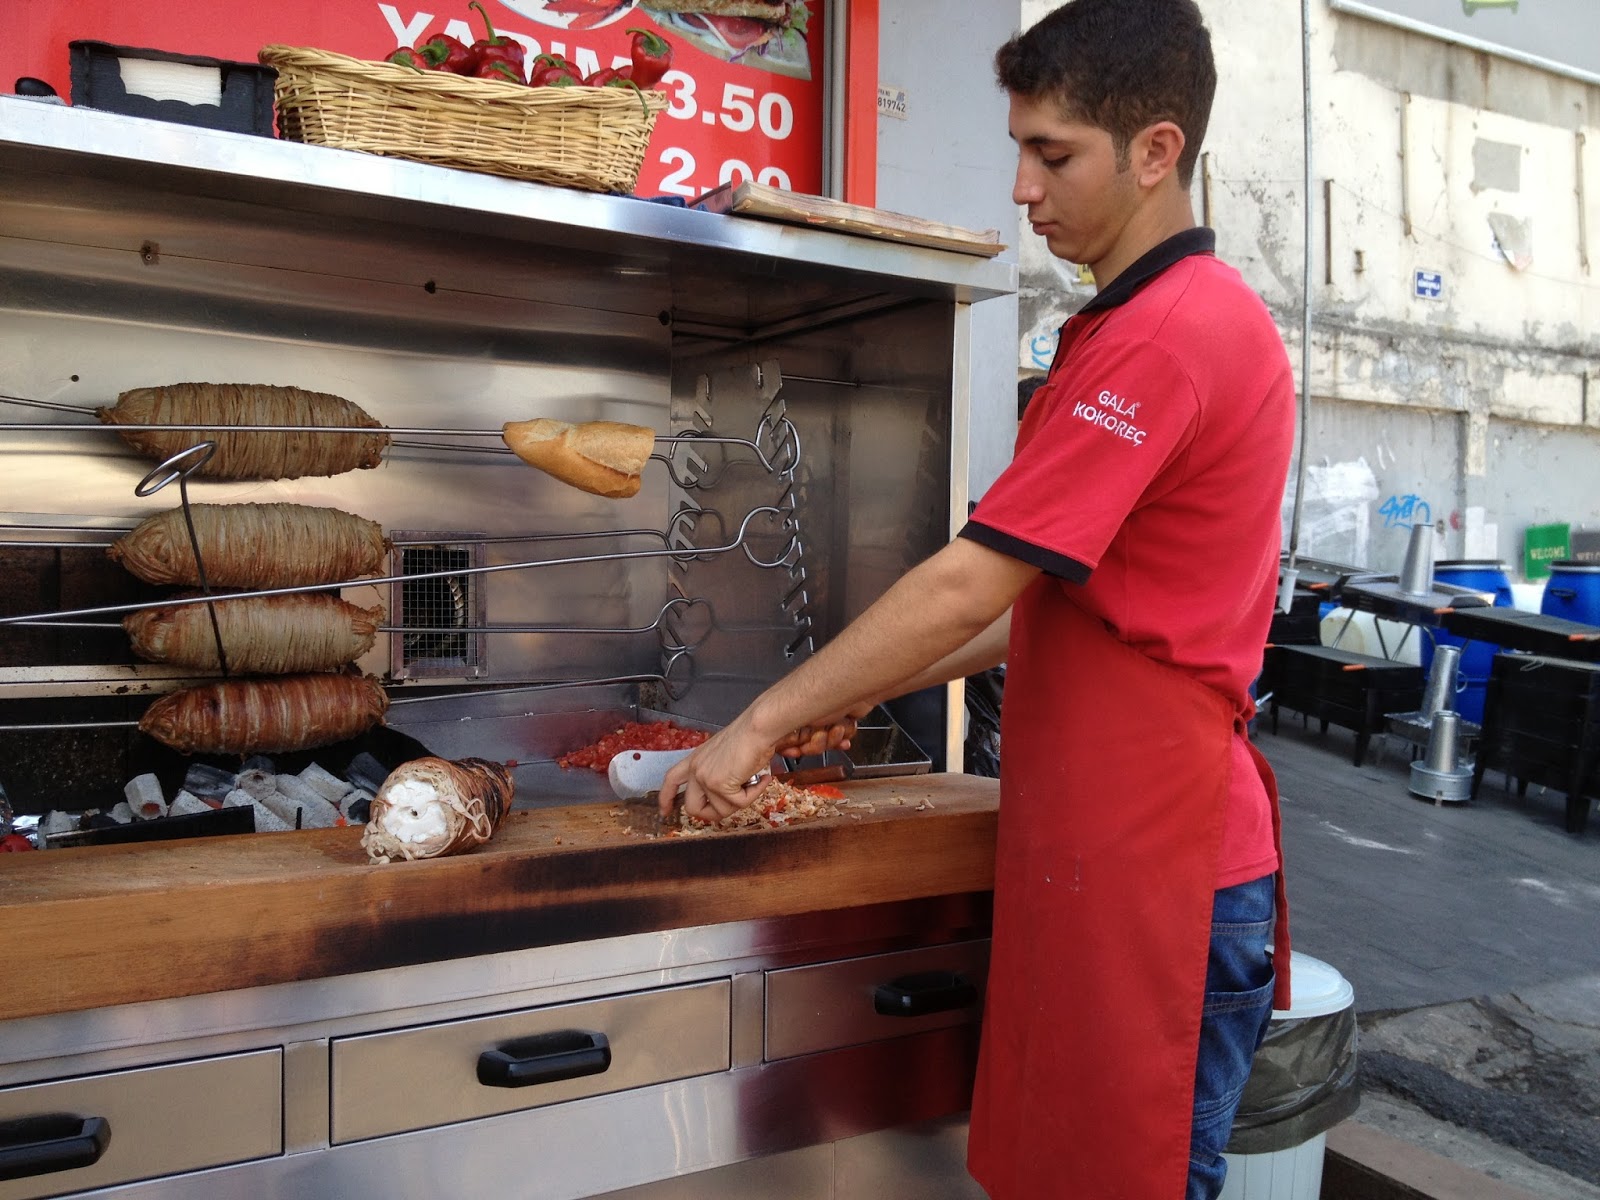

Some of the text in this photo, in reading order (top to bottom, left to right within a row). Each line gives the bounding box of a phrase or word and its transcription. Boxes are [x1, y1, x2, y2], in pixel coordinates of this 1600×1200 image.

[660, 69, 794, 140] 3.50
[1072, 400, 1147, 447] KOKOREÇ
[1530, 545, 1566, 560] WELCOME
